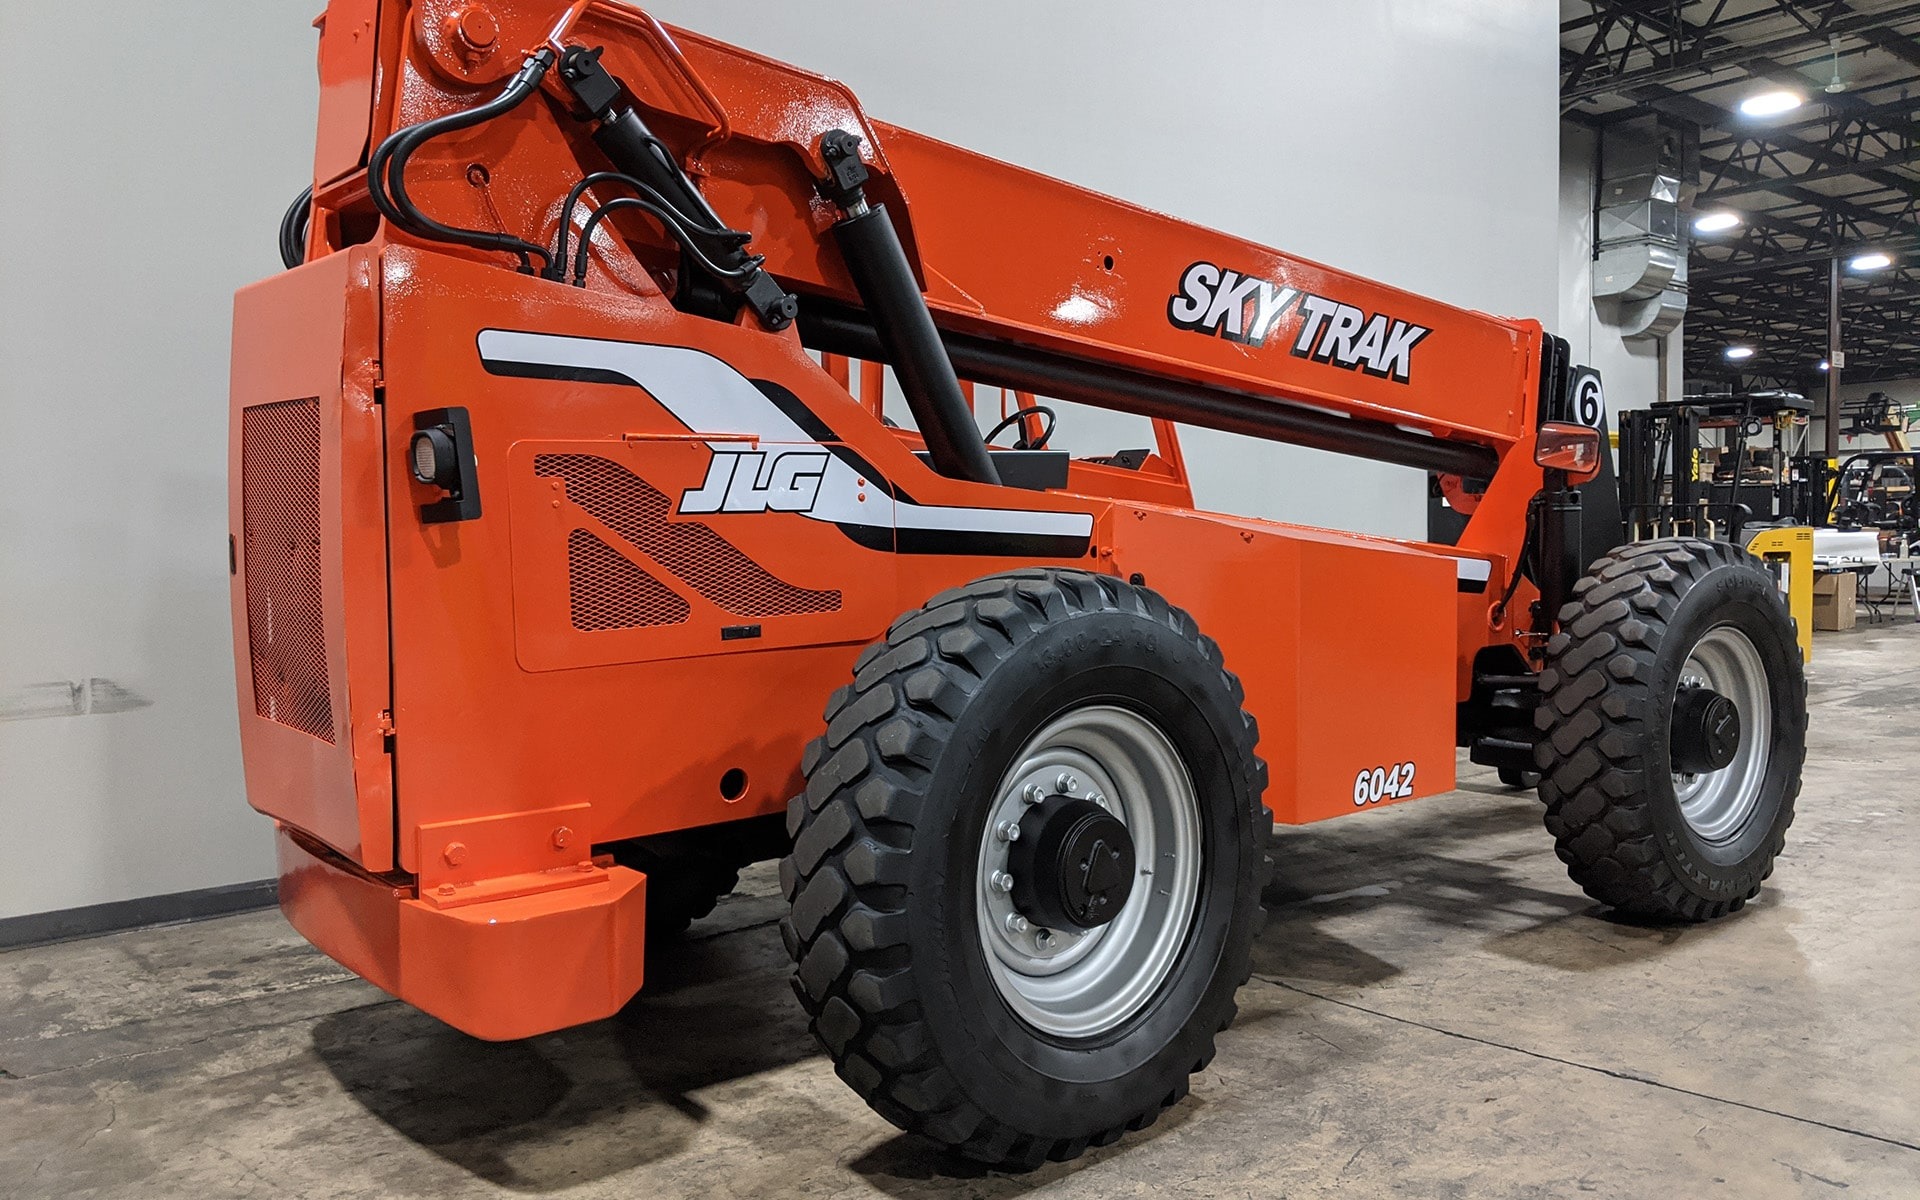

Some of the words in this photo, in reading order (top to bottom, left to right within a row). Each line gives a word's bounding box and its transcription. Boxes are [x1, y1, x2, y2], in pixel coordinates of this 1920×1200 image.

[1168, 262, 1300, 347] SKY
[1291, 294, 1432, 384] TRAK
[1580, 381, 1598, 426] 6
[676, 451, 831, 515] JLG
[1353, 761, 1416, 806] 6042
